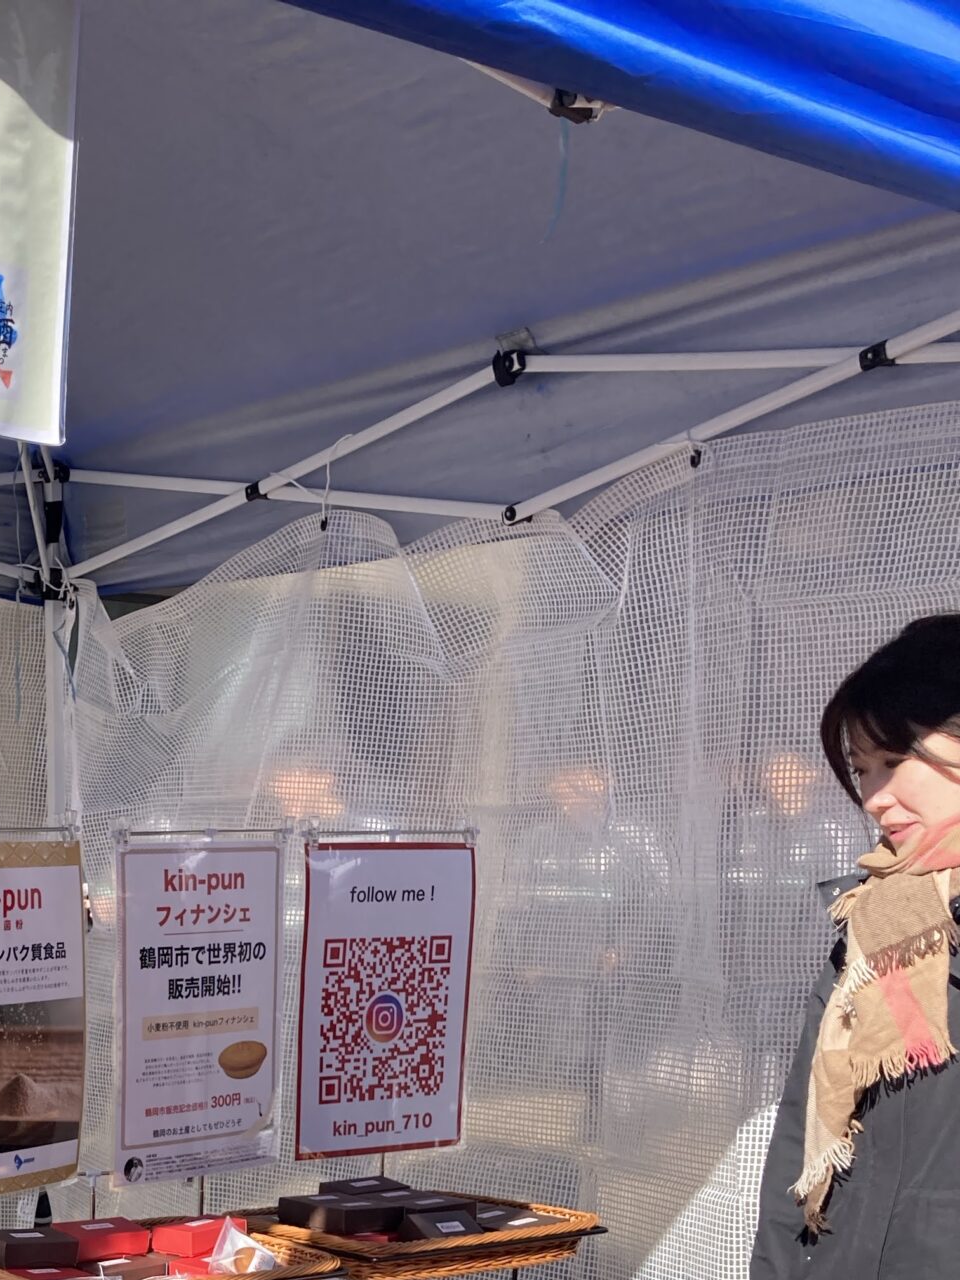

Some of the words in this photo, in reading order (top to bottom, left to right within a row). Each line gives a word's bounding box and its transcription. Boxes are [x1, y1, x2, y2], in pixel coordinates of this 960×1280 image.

[164, 869, 245, 895] kin-pun
[349, 886, 397, 903] follow
[156, 904, 251, 927] フィナンシェ
[139, 941, 267, 970] 鶴岡市で世界初の
[211, 1092, 241, 1109] 300円
[332, 1112, 433, 1137] kin_pun_710
